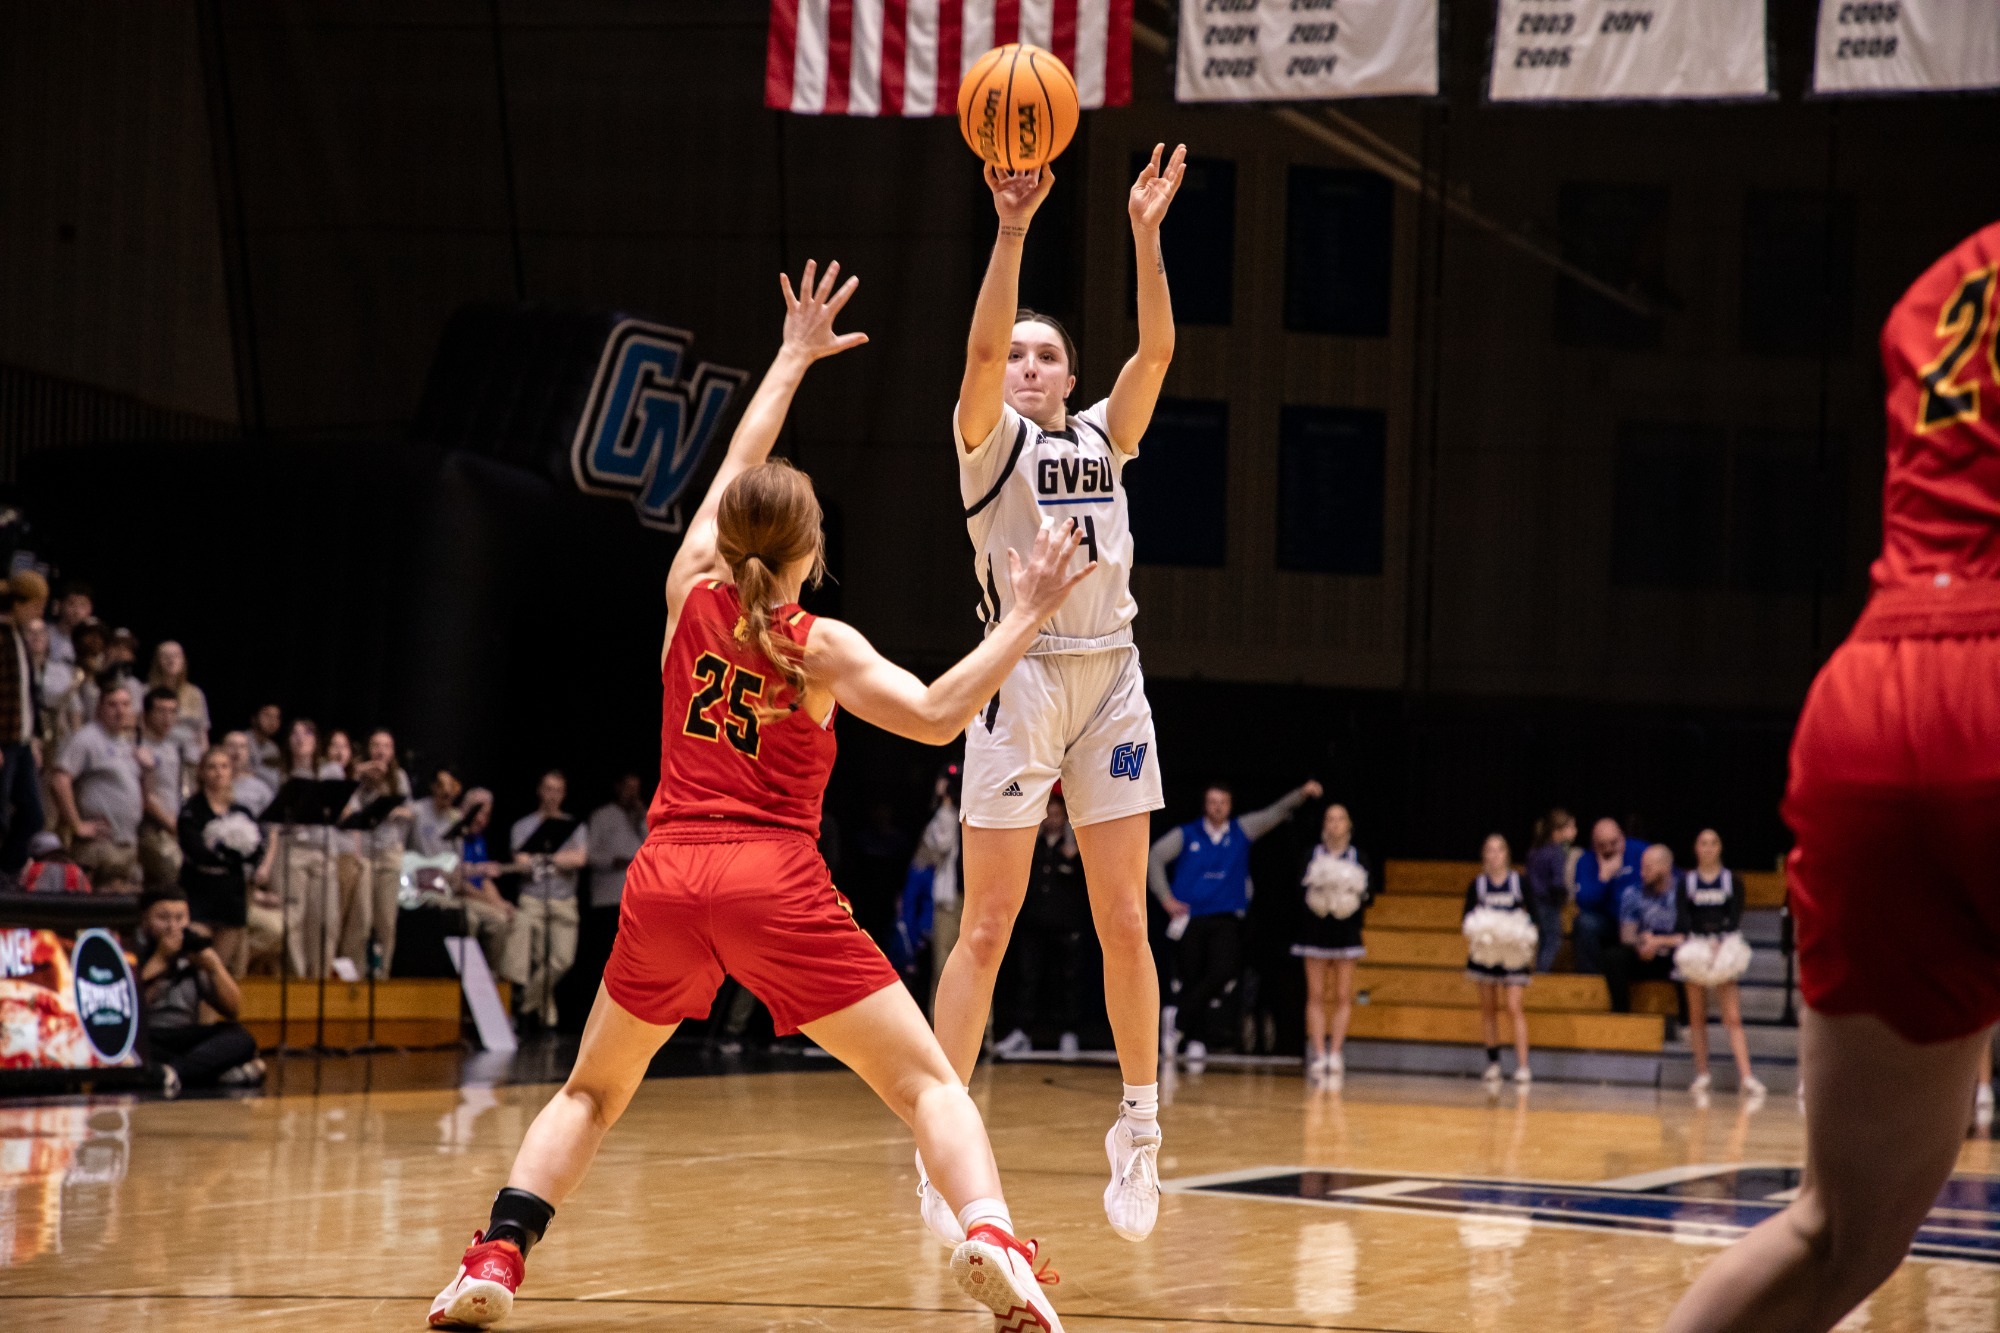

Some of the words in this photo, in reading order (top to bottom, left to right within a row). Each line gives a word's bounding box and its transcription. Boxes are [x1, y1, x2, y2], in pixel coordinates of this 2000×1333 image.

[1018, 103, 1036, 159] NCAA
[1915, 264, 2000, 435] 2
[571, 317, 749, 533] GV
[1038, 456, 1114, 494] GVSU
[1068, 515, 1098, 563] 4
[683, 650, 765, 760] 25
[1110, 741, 1148, 781] GV
